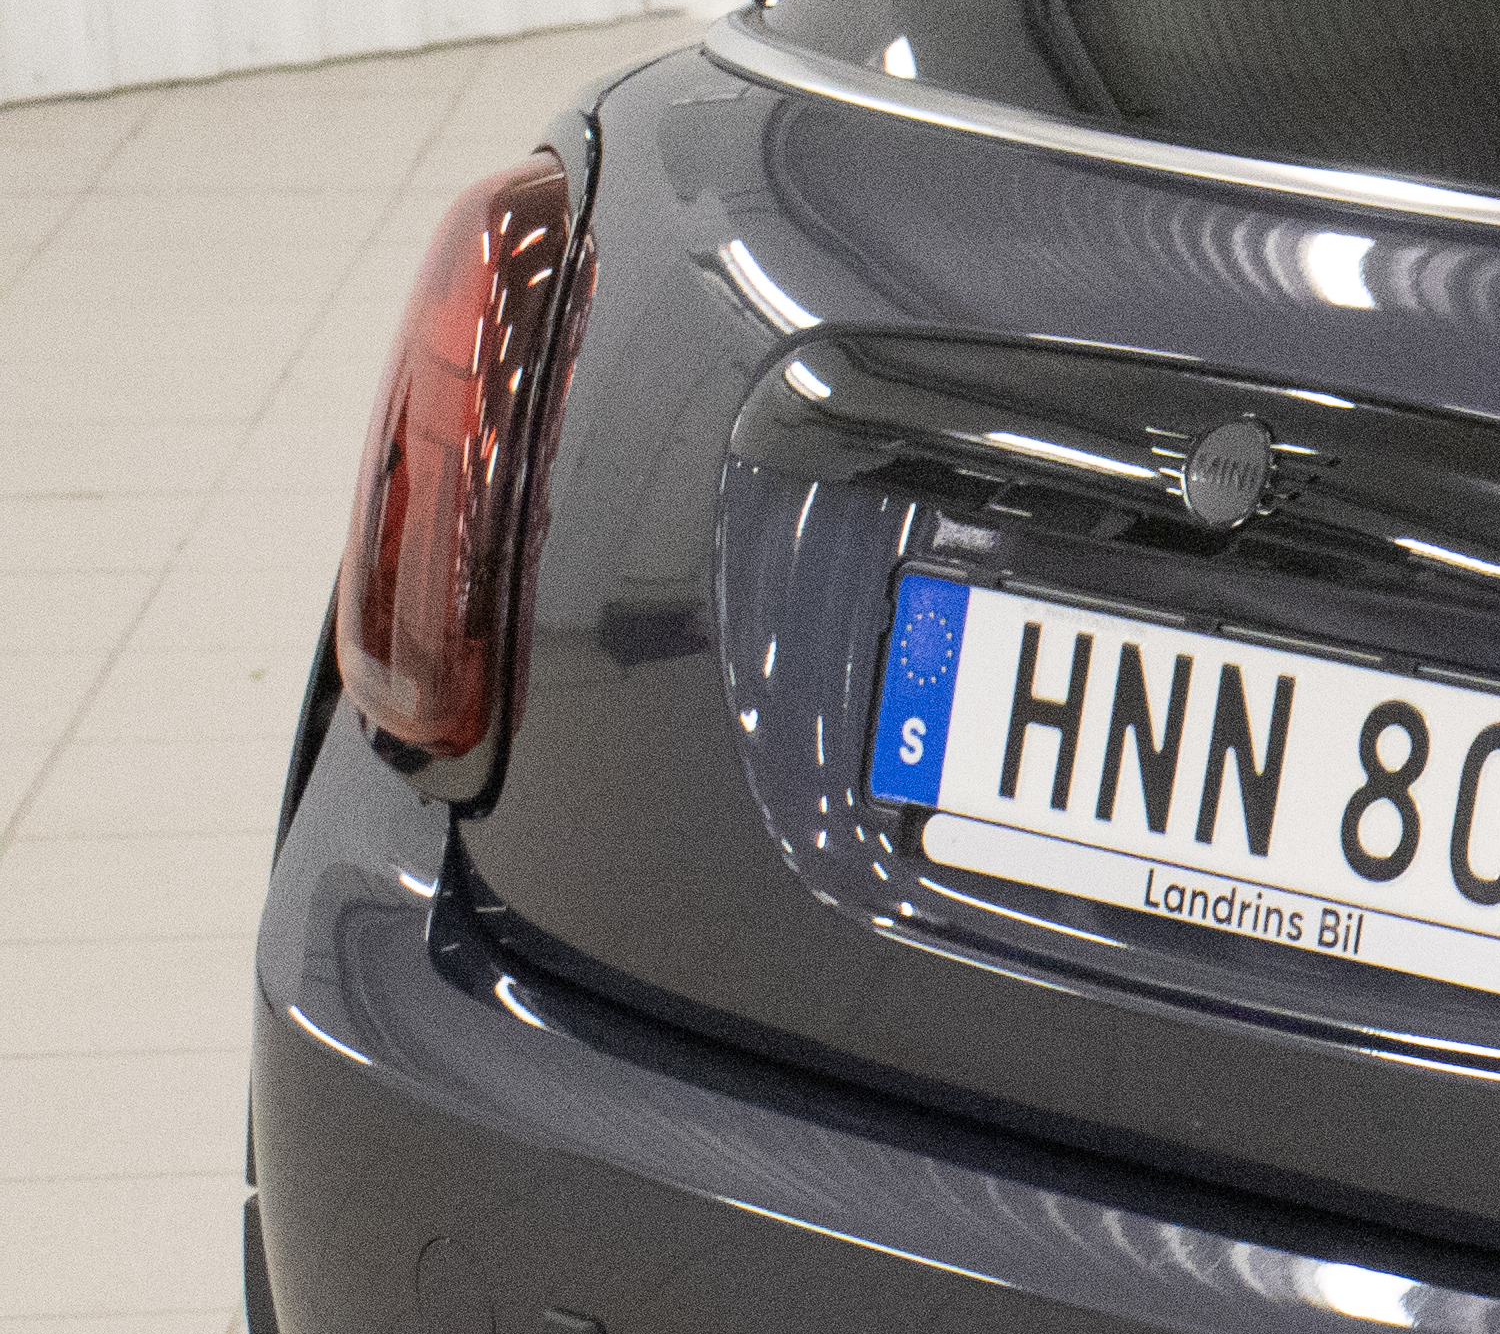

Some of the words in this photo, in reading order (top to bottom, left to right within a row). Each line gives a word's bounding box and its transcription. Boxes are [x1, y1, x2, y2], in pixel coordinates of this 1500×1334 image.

[900, 718, 927, 765] S
[1000, 623, 1294, 857] HNN
[1143, 867, 1304, 941] Landrins
[1317, 906, 1365, 955] Bil
